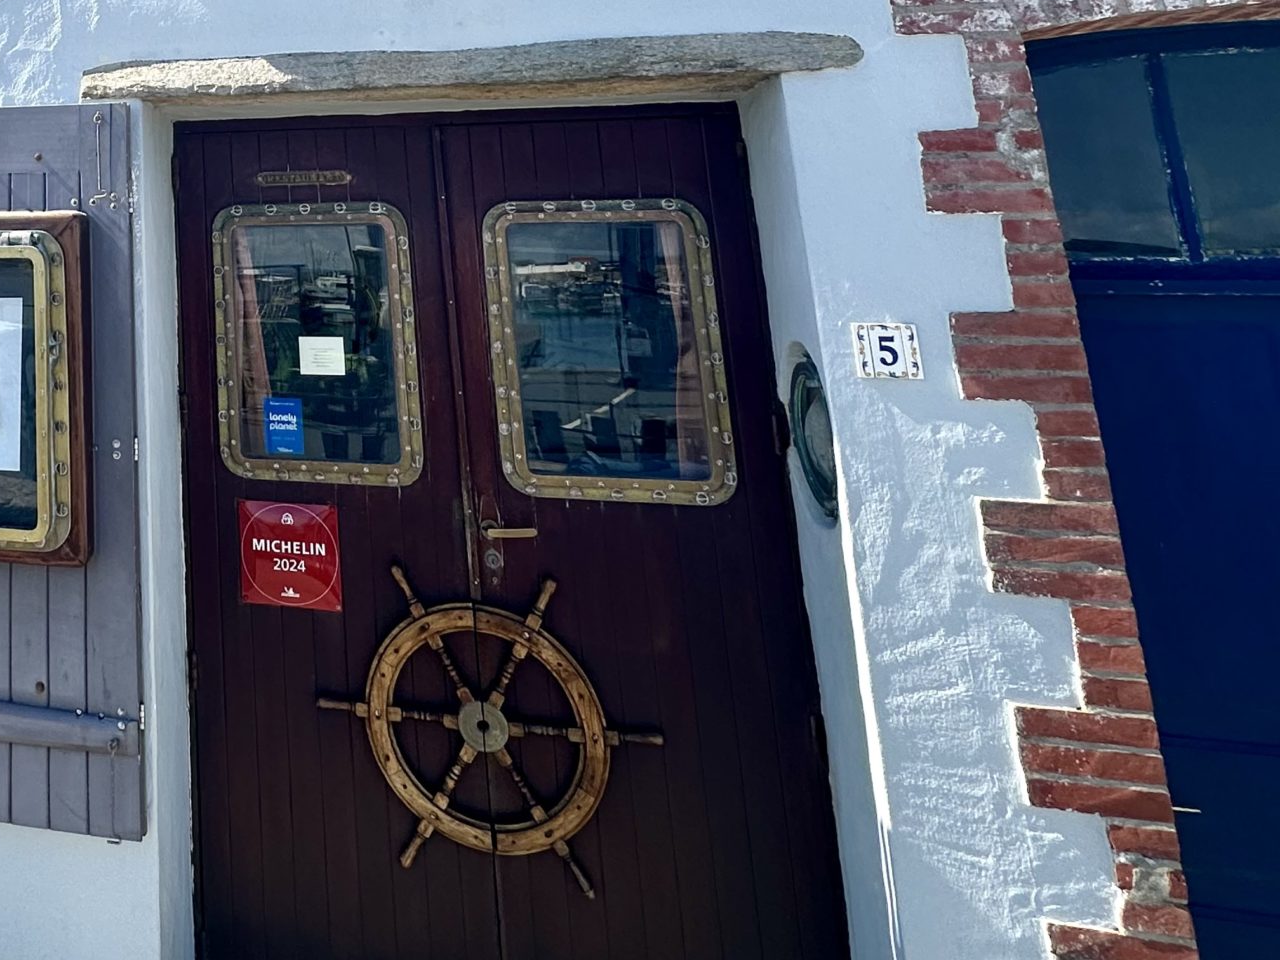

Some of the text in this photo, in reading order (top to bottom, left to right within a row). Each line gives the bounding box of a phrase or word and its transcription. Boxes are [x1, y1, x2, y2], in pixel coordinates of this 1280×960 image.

[878, 336, 898, 366] 5
[269, 412, 297, 424] lonely
[269, 421, 298, 431] planet
[252, 538, 326, 556] MICHELIN
[273, 558, 306, 573] 2024
